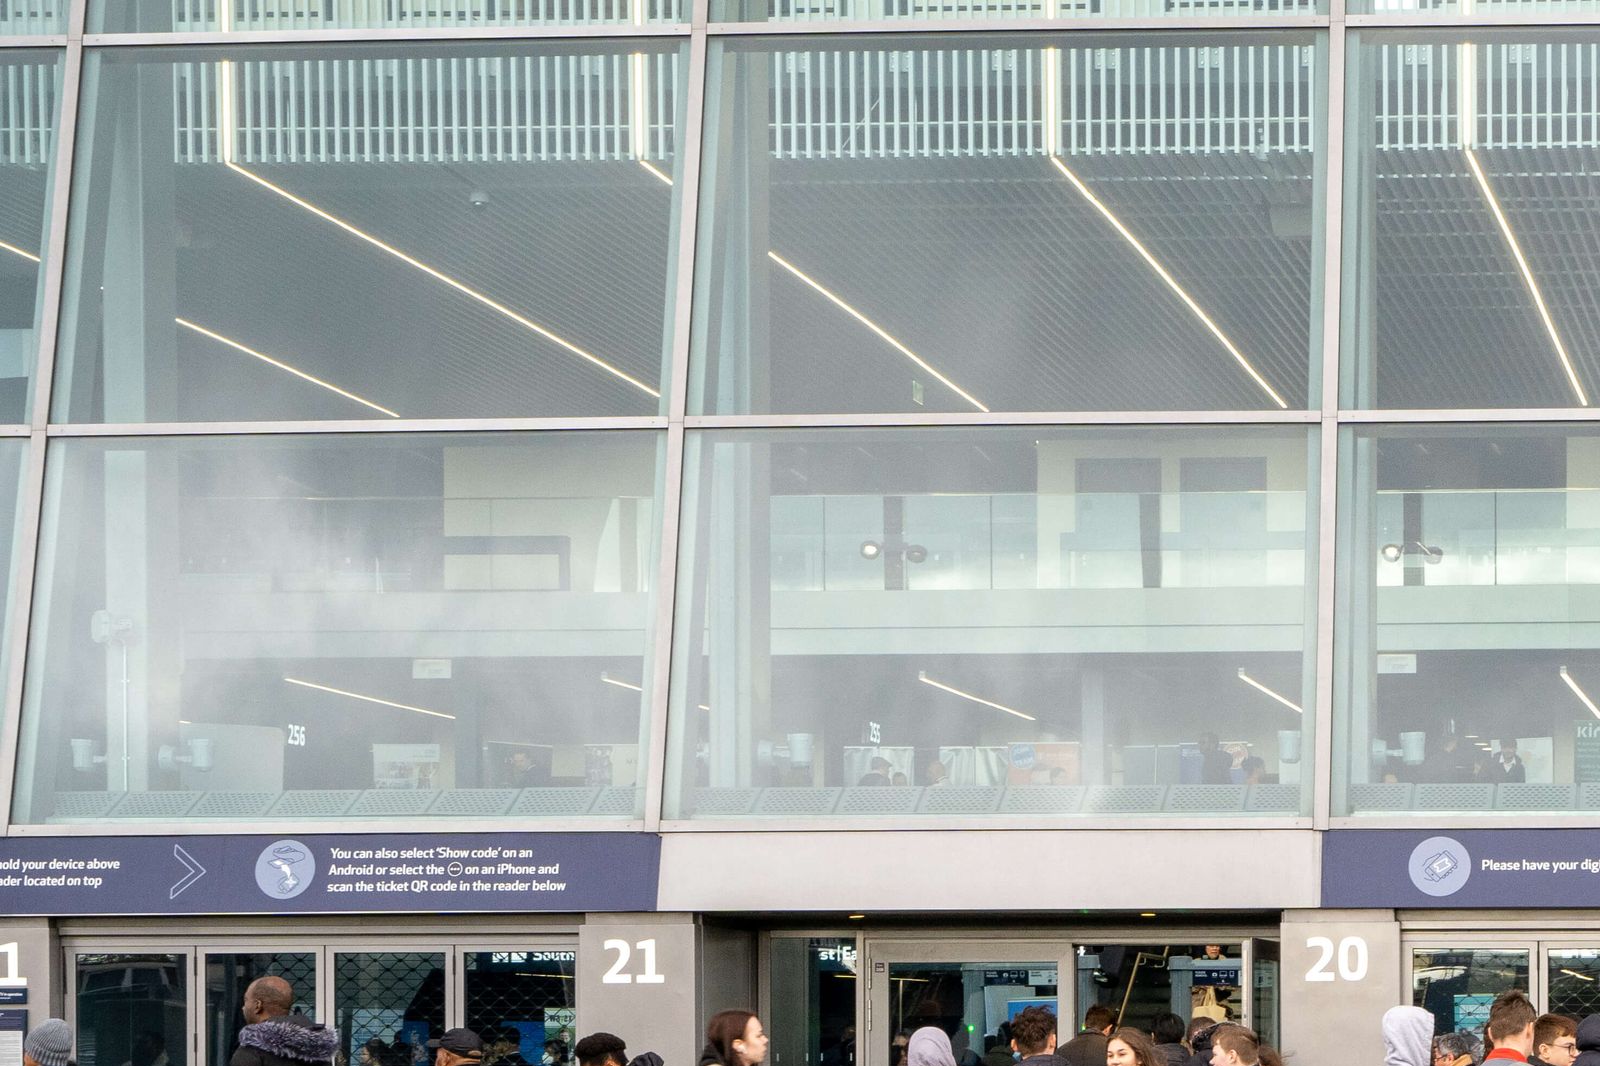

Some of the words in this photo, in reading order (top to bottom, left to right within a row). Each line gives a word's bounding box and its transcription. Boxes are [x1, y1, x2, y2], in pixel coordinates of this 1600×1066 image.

[288, 724, 306, 746] 256
[330, 848, 351, 859] You
[353, 850, 373, 859] can
[375, 847, 398, 859] also
[400, 847, 434, 859] select
[503, 849, 517, 858] on
[518, 849, 533, 858] an
[22, 861, 47, 873] your
[49, 858, 85, 870] device
[87, 858, 120, 869] above
[328, 864, 373, 876] Android
[375, 867, 388, 875] or
[389, 864, 424, 875] select
[426, 864, 445, 875] the
[465, 866, 479, 875] on
[481, 866, 495, 875] an
[497, 864, 536, 875] iPhone
[538, 864, 559, 875] and
[1481, 859, 1520, 871] Please
[1522, 859, 1550, 870] have
[1552, 862, 1578, 873] your
[24, 875, 65, 886] located
[67, 877, 81, 886] on
[83, 876, 102, 888] top
[327, 883, 353, 892] scan
[355, 881, 374, 892] the
[376, 881, 409, 892] ticket
[410, 881, 428, 893] QR
[430, 881, 457, 891] code
[459, 880, 470, 891] in
[472, 880, 491, 891] the
[493, 880, 530, 891] reader
[532, 880, 566, 891] below
[602, 938, 665, 984] 21
[1305, 936, 1369, 982] 20
